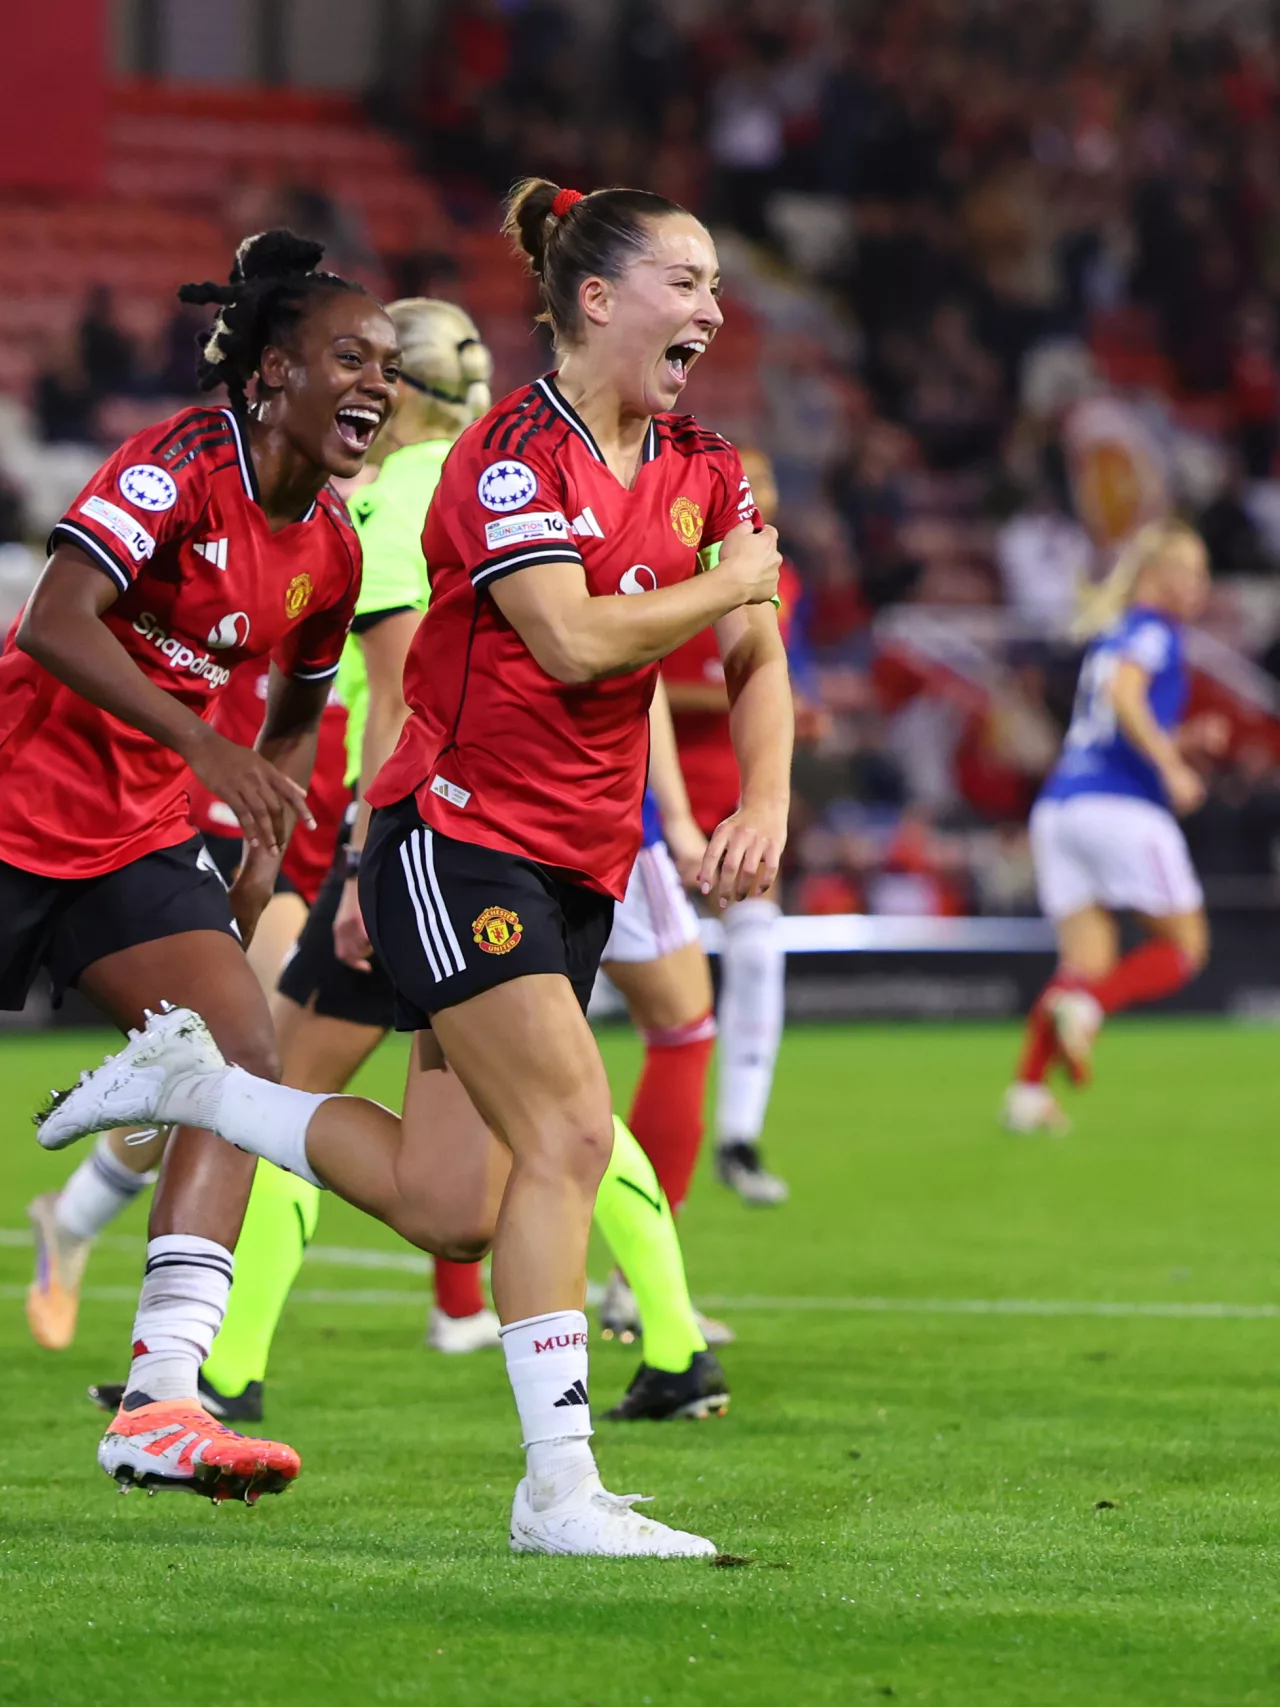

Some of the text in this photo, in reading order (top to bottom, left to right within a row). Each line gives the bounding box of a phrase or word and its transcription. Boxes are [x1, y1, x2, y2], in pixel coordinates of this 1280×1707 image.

[132, 611, 230, 690] Snapdrago
[476, 909, 516, 930] MANCHESTER
[488, 939, 516, 952] UNITED
[533, 1332, 588, 1354] MUFC
